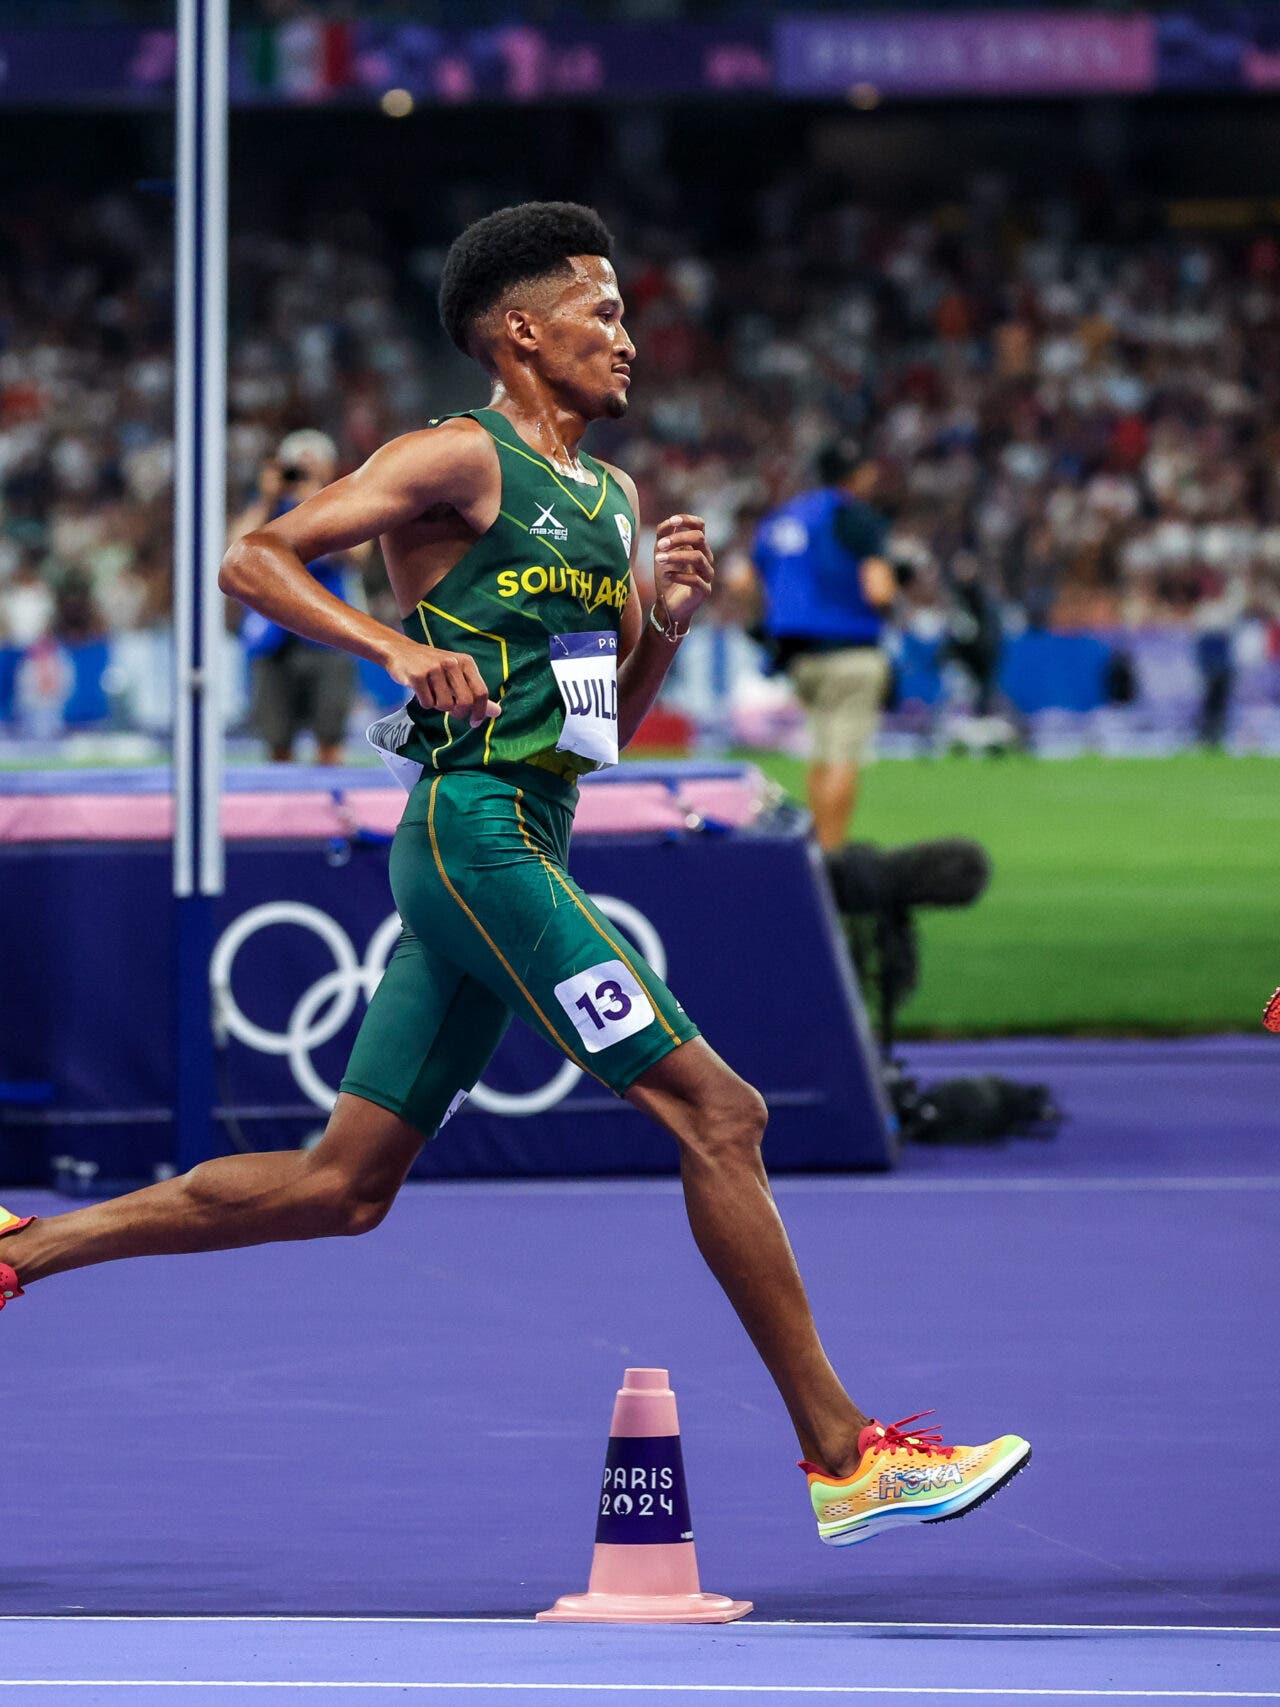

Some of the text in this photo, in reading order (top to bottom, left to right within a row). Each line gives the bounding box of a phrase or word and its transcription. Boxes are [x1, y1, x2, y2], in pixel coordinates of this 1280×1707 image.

[496, 566, 593, 601] SOUTH
[575, 979, 632, 1031] 13
[878, 1462, 963, 1500] HOKA
[600, 1494, 673, 1516] 2024
